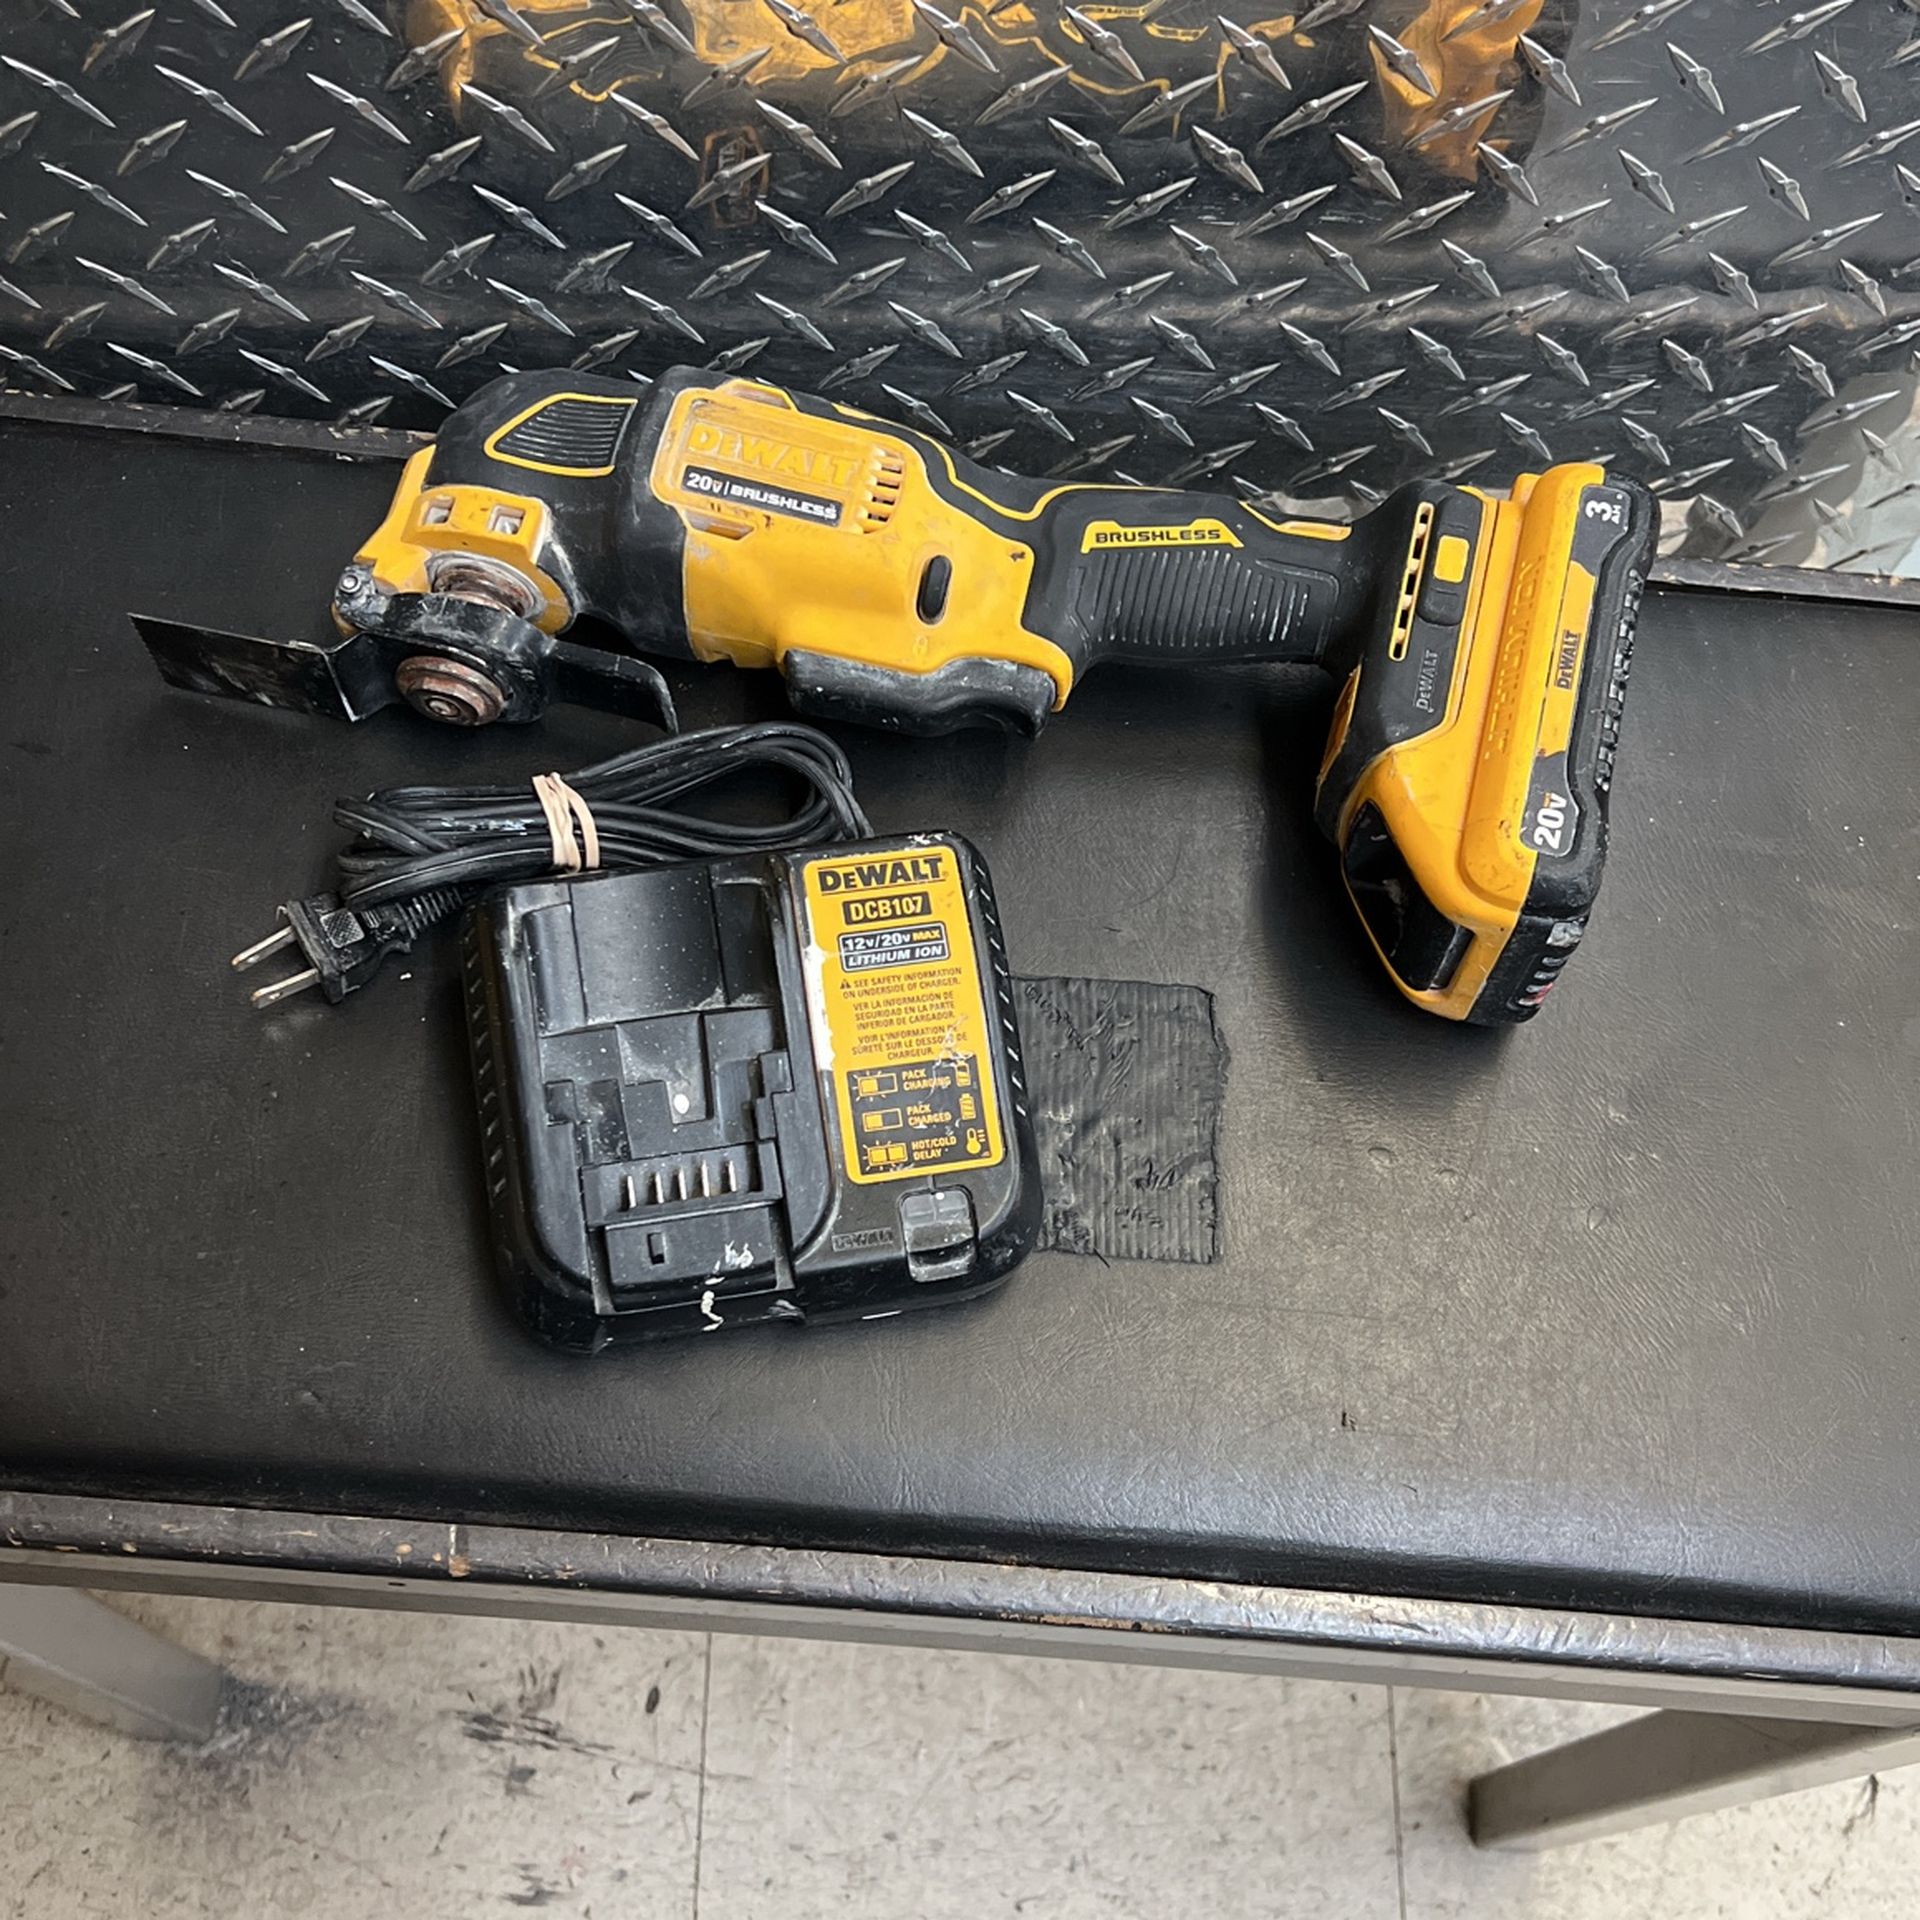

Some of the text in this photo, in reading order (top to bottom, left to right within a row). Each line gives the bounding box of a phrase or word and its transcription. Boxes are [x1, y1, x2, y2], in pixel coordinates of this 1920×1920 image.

[730, 484, 837, 520] BRUSHLESS
[1585, 499, 1612, 522] 3
[1611, 504, 1622, 525] AH
[1095, 529, 1221, 544] BRUSHLESS
[850, 896, 923, 921] DCB107
[912, 929, 940, 941] MAX
[848, 945, 943, 967] LITHIUM ION
[854, 967, 962, 988] SEE SAFETY INFORMATION
[842, 990, 856, 999] ON
[858, 983, 904, 998] UNDERSIDE
[907, 982, 917, 991] OF
[853, 1001, 869, 1011] VER
[871, 1000, 882, 1009] LA
[943, 990, 953, 1000] DE
[855, 1000, 954, 1021] SEGURIDAD EN LA PARTE
[856, 1018, 894, 1030] INFERIOR
[896, 1016, 907, 1026] DE
[858, 1034, 878, 1044] VOIR
[880, 1025, 945, 1042] L'INFORMATION
[885, 1040, 902, 1051] SUR
[904, 1038, 913, 1048] LE
[915, 1032, 954, 1047] DESSO
[956, 1031, 968, 1041] DE
[902, 1068, 926, 1080] PACK
[903, 1076, 951, 1091] CHARGING
[907, 1104, 932, 1116] PACK
[908, 1111, 952, 1126] CHARGED
[912, 1135, 957, 1151] HOT/COLD
[913, 1148, 942, 1160] DELAY
